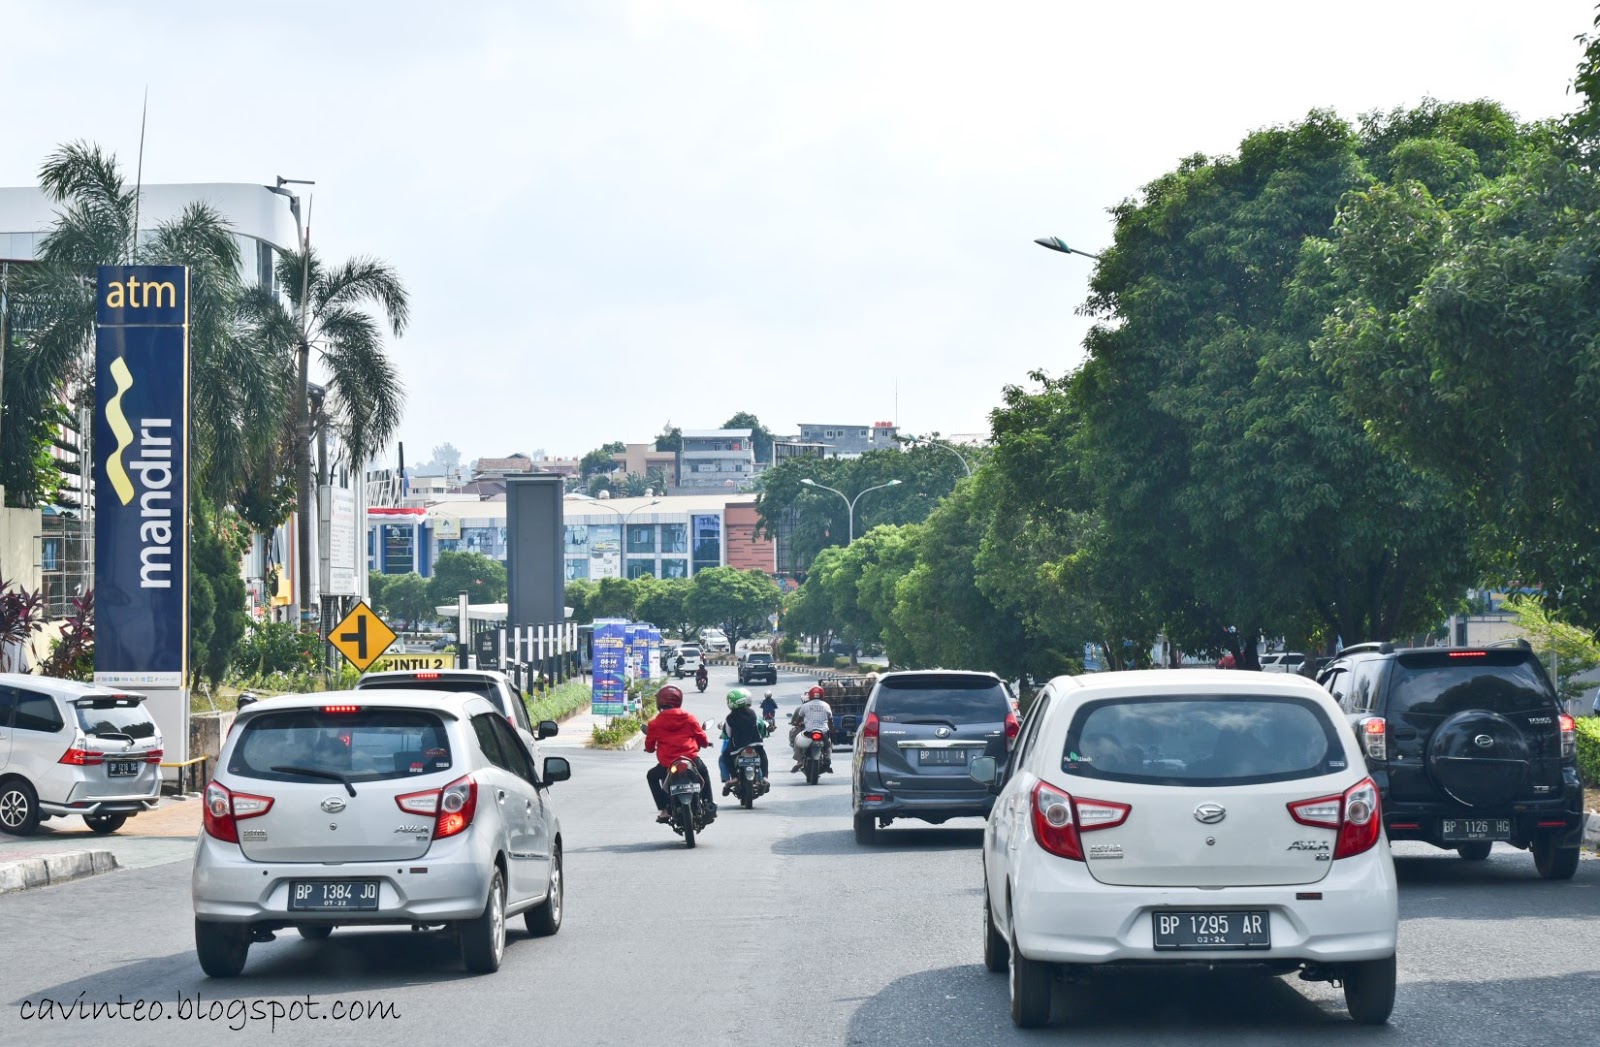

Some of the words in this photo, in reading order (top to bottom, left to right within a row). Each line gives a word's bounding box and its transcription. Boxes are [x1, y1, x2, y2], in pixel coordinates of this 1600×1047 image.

[106, 275, 176, 308] atm
[129, 418, 172, 588] mandiri
[383, 658, 429, 671] PINTU
[434, 658, 444, 670] 2
[920, 750, 930, 760] BP
[1443, 821, 1457, 833] BP
[1465, 821, 1488, 833] 1126
[1496, 820, 1509, 832] HG
[296, 884, 313, 900] BP
[323, 884, 352, 899] 1384
[1160, 916, 1180, 934] BP
[1190, 915, 1229, 934] 1295
[1242, 915, 1262, 934] AR
